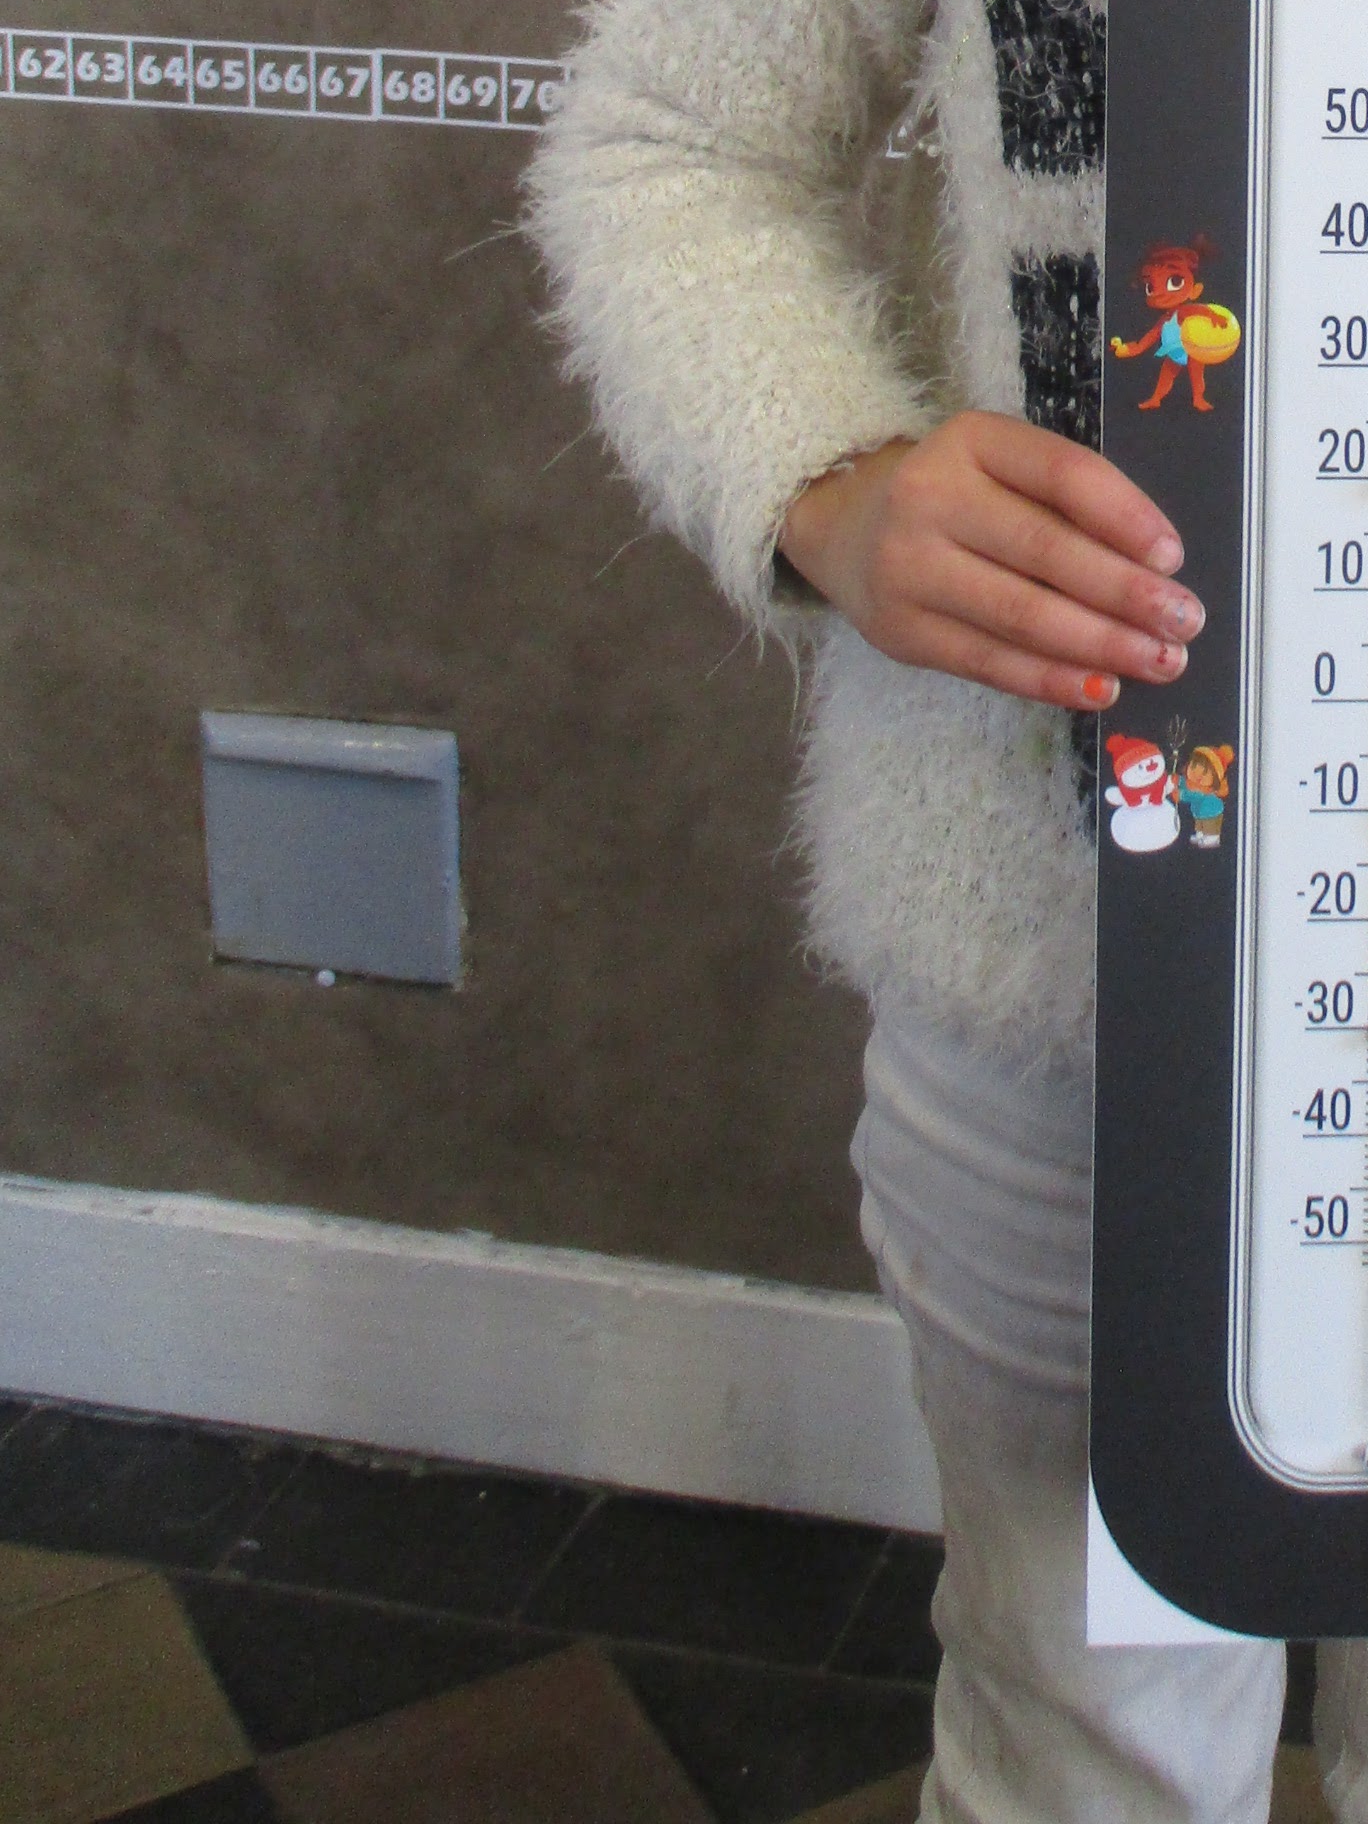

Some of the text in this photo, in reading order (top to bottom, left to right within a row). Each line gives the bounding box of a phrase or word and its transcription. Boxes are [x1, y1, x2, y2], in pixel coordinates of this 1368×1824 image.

[19, 48, 66, 79] 62
[76, 52, 125, 83] 63
[137, 55, 187, 87] 64
[195, 58, 245, 91] 65
[257, 61, 307, 95] 66
[319, 65, 372, 98] 67
[384, 69, 435, 103] 68
[446, 73, 498, 107] 69
[1322, 203, 1368, 247] 40
[1320, 316, 1367, 361] 30
[1318, 429, 1365, 473] 20
[1317, 541, 1364, 584] 10
[1314, 652, 1335, 695] 0
